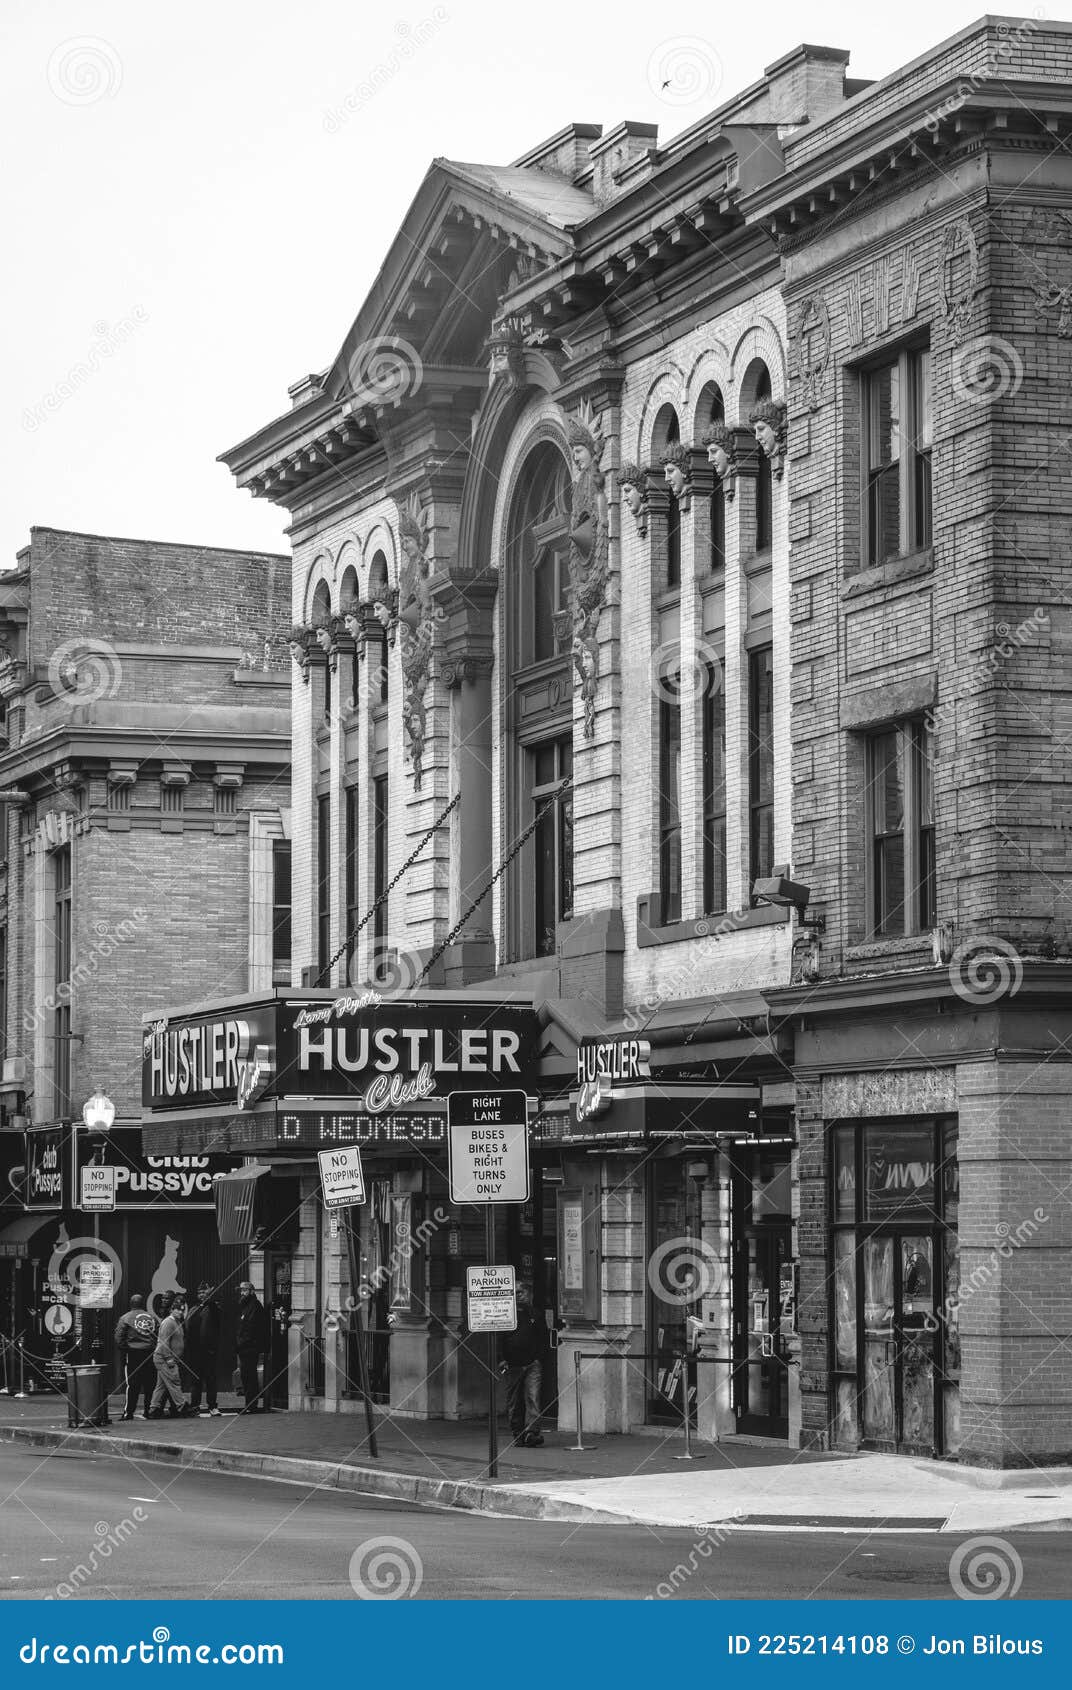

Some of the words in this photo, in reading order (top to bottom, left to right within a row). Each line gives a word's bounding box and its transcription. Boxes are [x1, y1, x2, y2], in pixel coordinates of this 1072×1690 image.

[300, 1028, 521, 1072] HUSTLER
[151, 1021, 239, 1097] HUSTLER
[577, 1041, 639, 1082] HUSTLER
[366, 1062, 436, 1113] Club
[472, 1097, 501, 1108] RIGHT
[474, 1110, 501, 1121] LANE
[320, 1116, 444, 1139] WEDNESD
[471, 1130, 505, 1140] BUSES
[468, 1143, 500, 1153] BIKES
[501, 1143, 508, 1152] &
[331, 1155, 347, 1167] NO
[474, 1157, 503, 1167] RIGHT
[91, 1171, 104, 1180] NO
[114, 1166, 228, 1196] Pussyc
[324, 1169, 360, 1183] STOPPING
[472, 1170, 506, 1181] TURNS
[84, 1183, 113, 1191] STOPPING
[476, 1183, 502, 1194] ONLY
[484, 1269, 497, 1277] NO
[471, 1277, 510, 1286] PARKING
